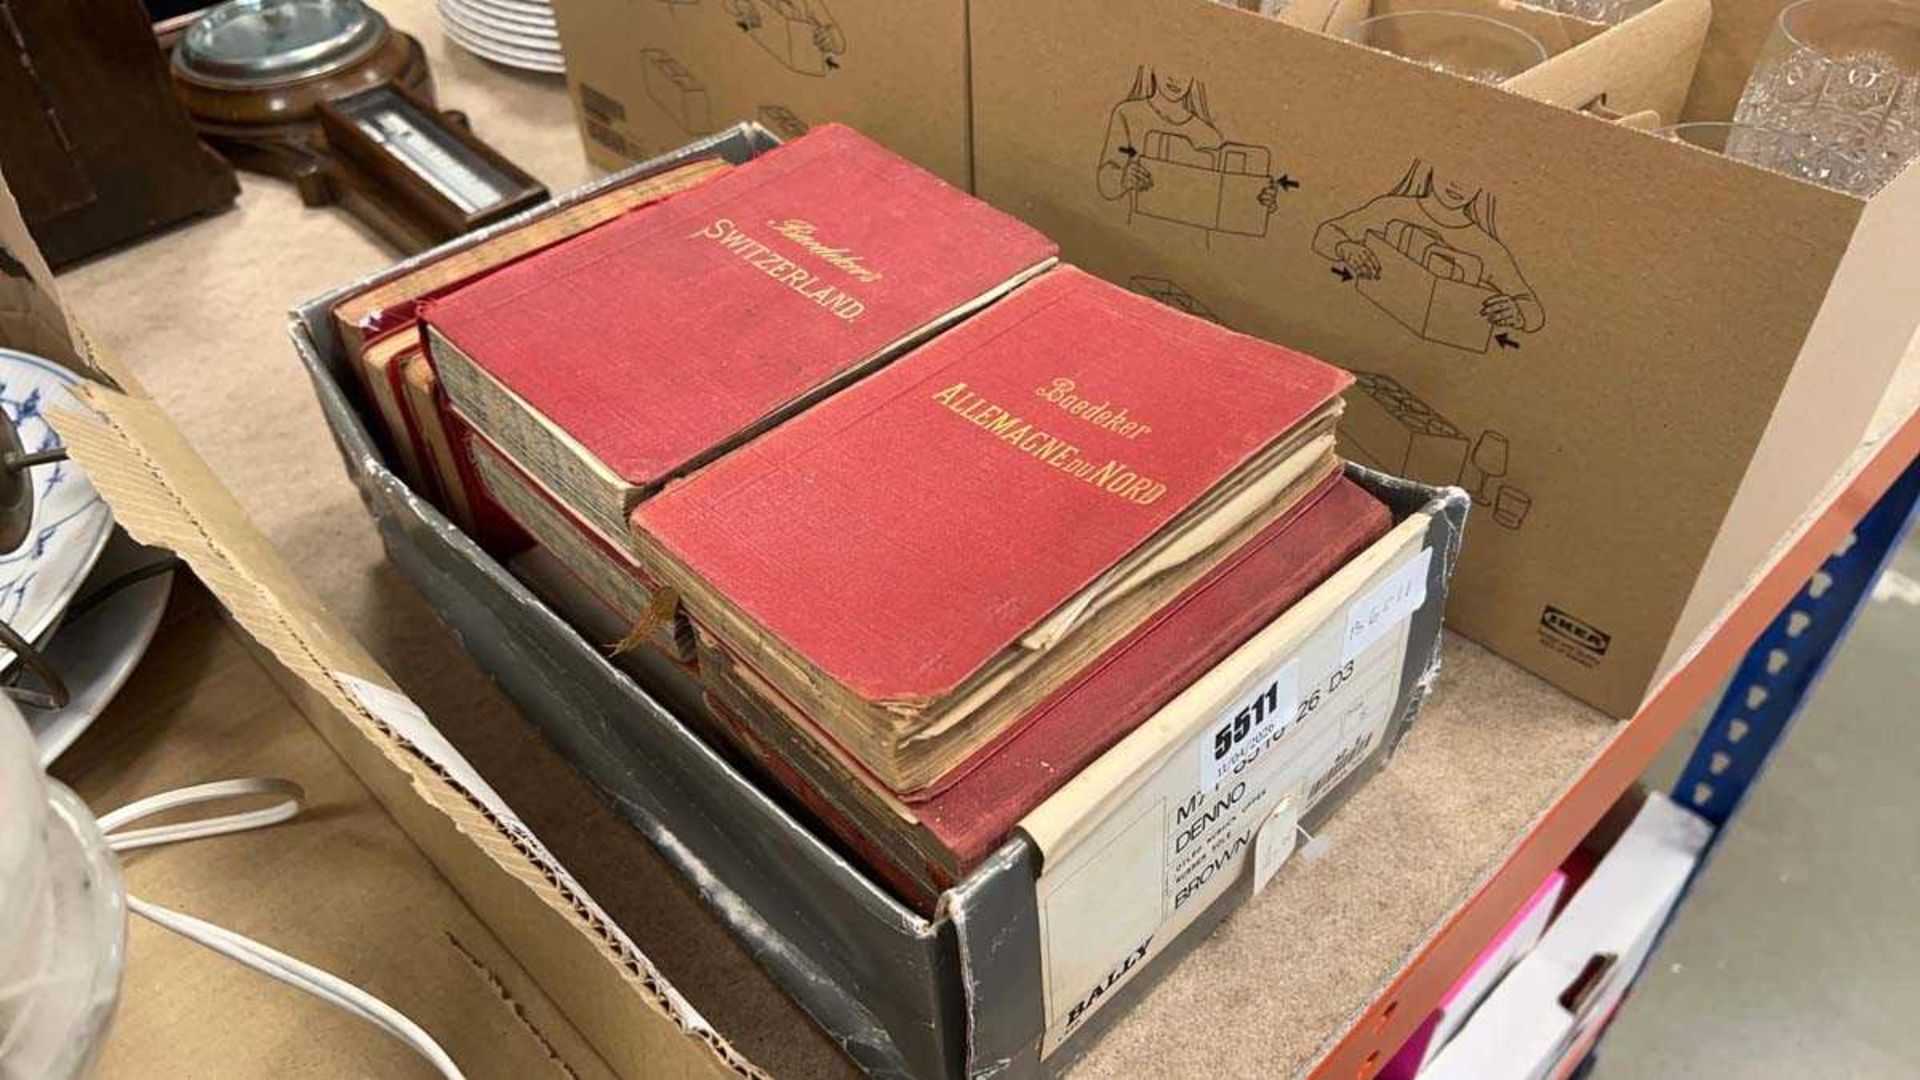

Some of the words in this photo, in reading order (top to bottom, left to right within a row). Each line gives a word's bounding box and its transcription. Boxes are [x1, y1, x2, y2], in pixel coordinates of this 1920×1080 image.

[932, 382, 1078, 466] ALLEMAGNE
[1064, 455, 1096, 483] DU
[1090, 460, 1167, 505] NORD
[1036, 378, 1152, 440] Baedeker
[1546, 611, 1605, 649] IKEA
[1215, 681, 1278, 760] 5511
[1295, 688, 1321, 723] 26
[1329, 659, 1354, 694] D3
[1176, 781, 1246, 853] DENNO
[1175, 828, 1251, 910] BROWN
[1065, 934, 1154, 1027] BALLY
